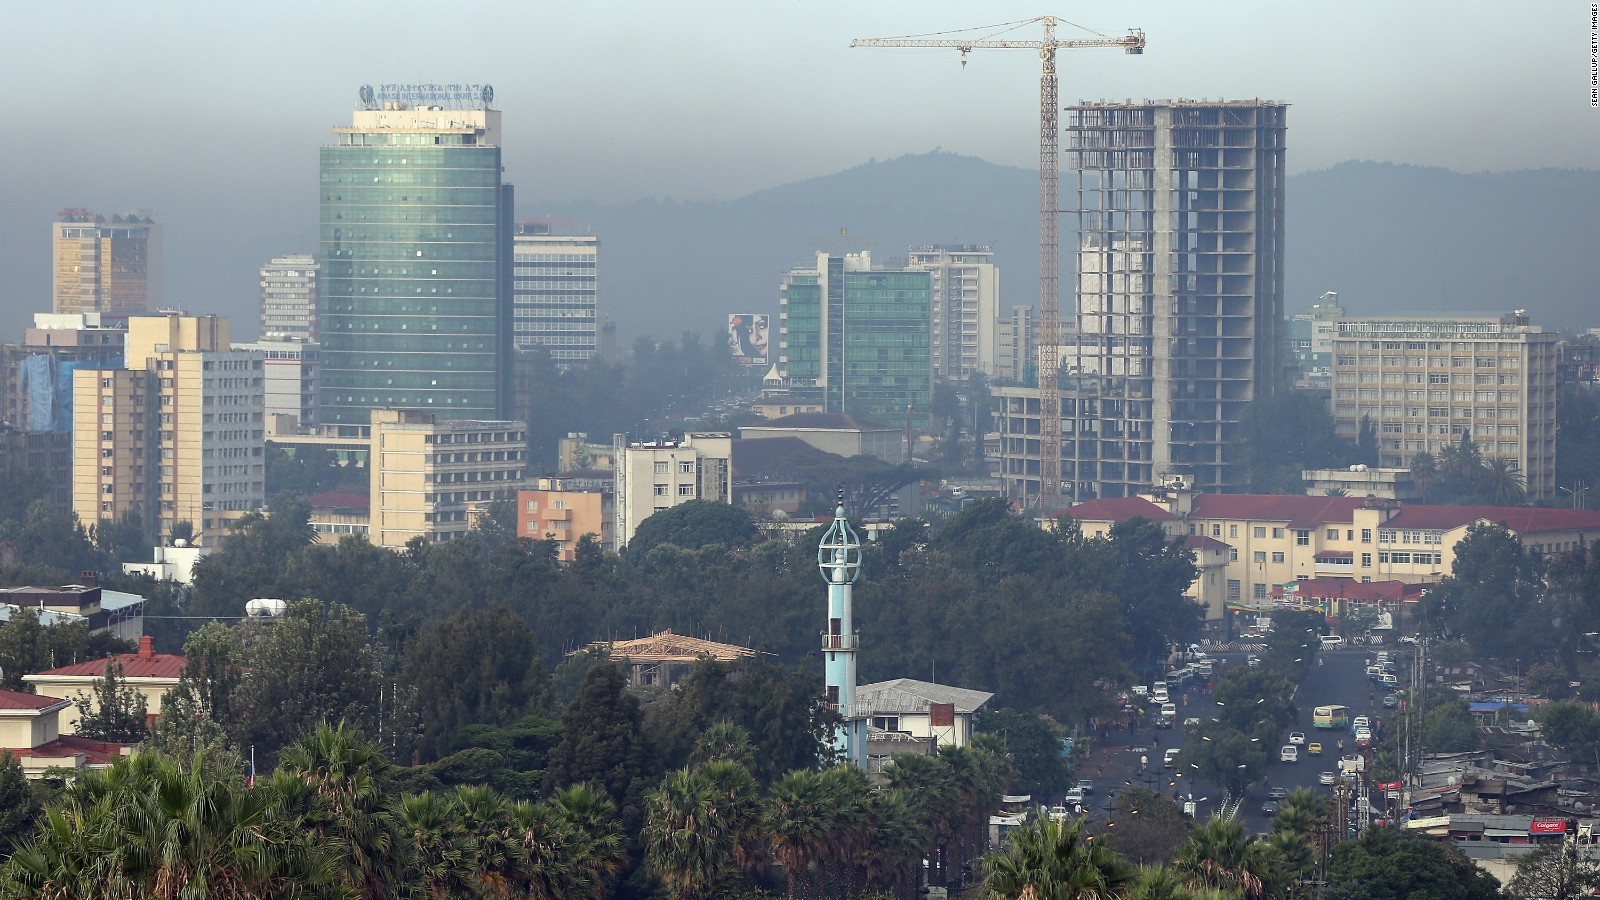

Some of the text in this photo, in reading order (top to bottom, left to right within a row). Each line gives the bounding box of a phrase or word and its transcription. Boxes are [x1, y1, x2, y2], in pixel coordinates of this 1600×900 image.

[377, 92, 400, 100] AWASH
[401, 92, 453, 100] INTERNATIONAL
[454, 92, 471, 100] BANK
[1339, 331, 1370, 339] MINISTRY
